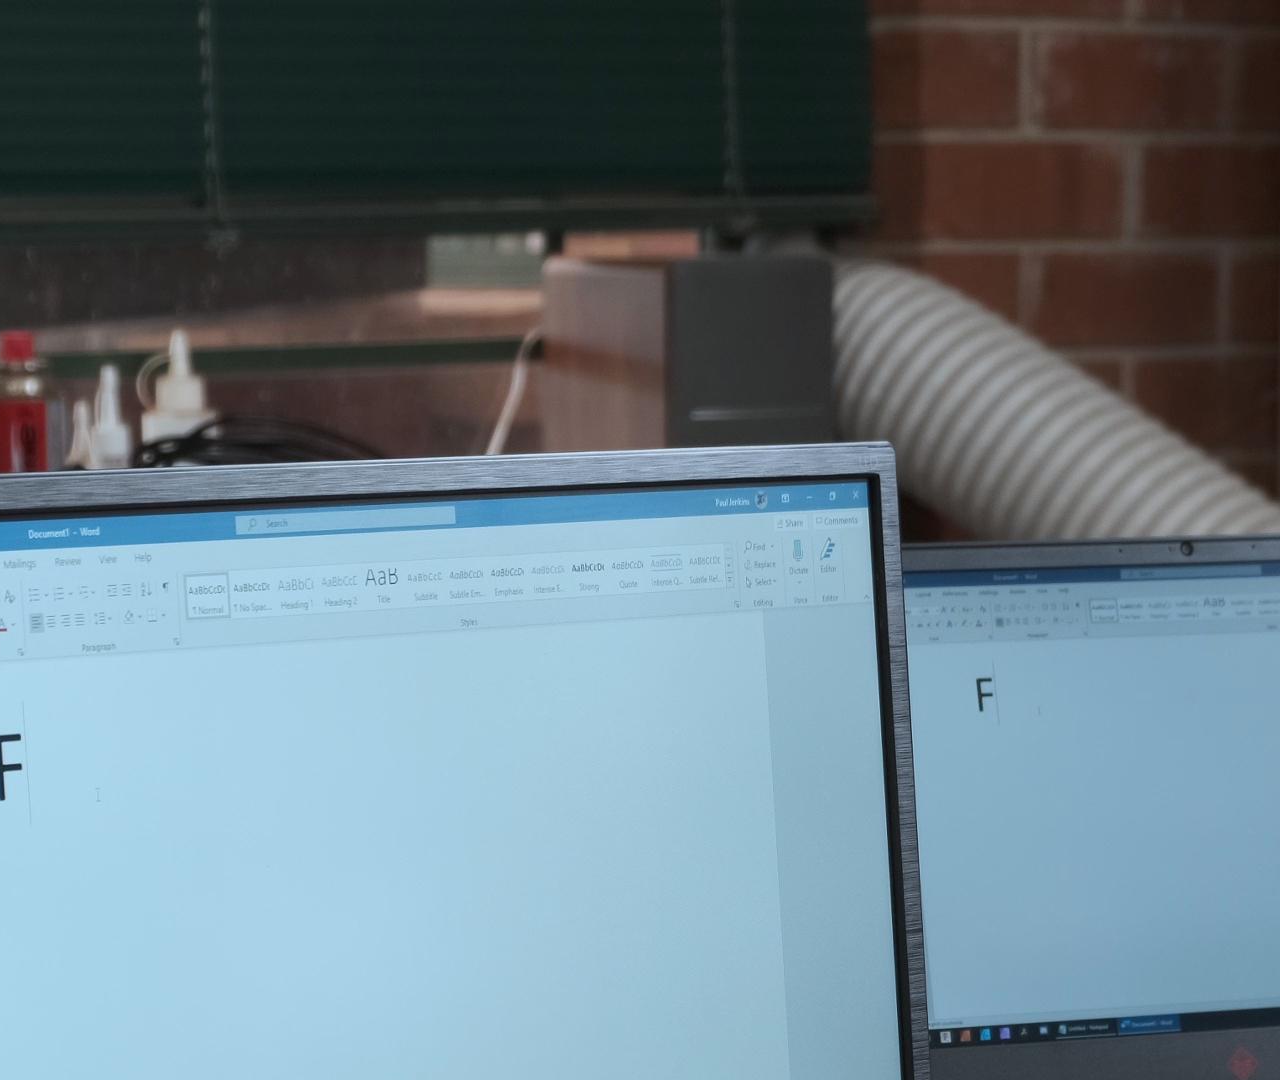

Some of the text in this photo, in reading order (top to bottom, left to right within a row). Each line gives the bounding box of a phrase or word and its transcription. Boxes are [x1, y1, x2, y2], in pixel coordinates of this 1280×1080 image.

[715, 498, 728, 507] Paul
[266, 517, 288, 529] Search
[785, 519, 804, 528] Share
[824, 516, 858, 526] Comments
[28, 527, 70, 540] Document1
[80, 526, 101, 537] Word
[752, 543, 766, 551] Find
[54, 557, 82, 567] Review
[99, 555, 117, 565] View
[134, 552, 152, 563] Help
[3, 559, 37, 571] Mailings
[755, 578, 772, 586] Select
[494, 588, 524, 598] Emphasis
[324, 598, 352, 608] Heading
[377, 594, 391, 604] Title
[198, 606, 224, 616] Normal
[280, 601, 309, 611] Heading
[82, 642, 117, 653] Paragraph
[976, 677, 993, 711] F
